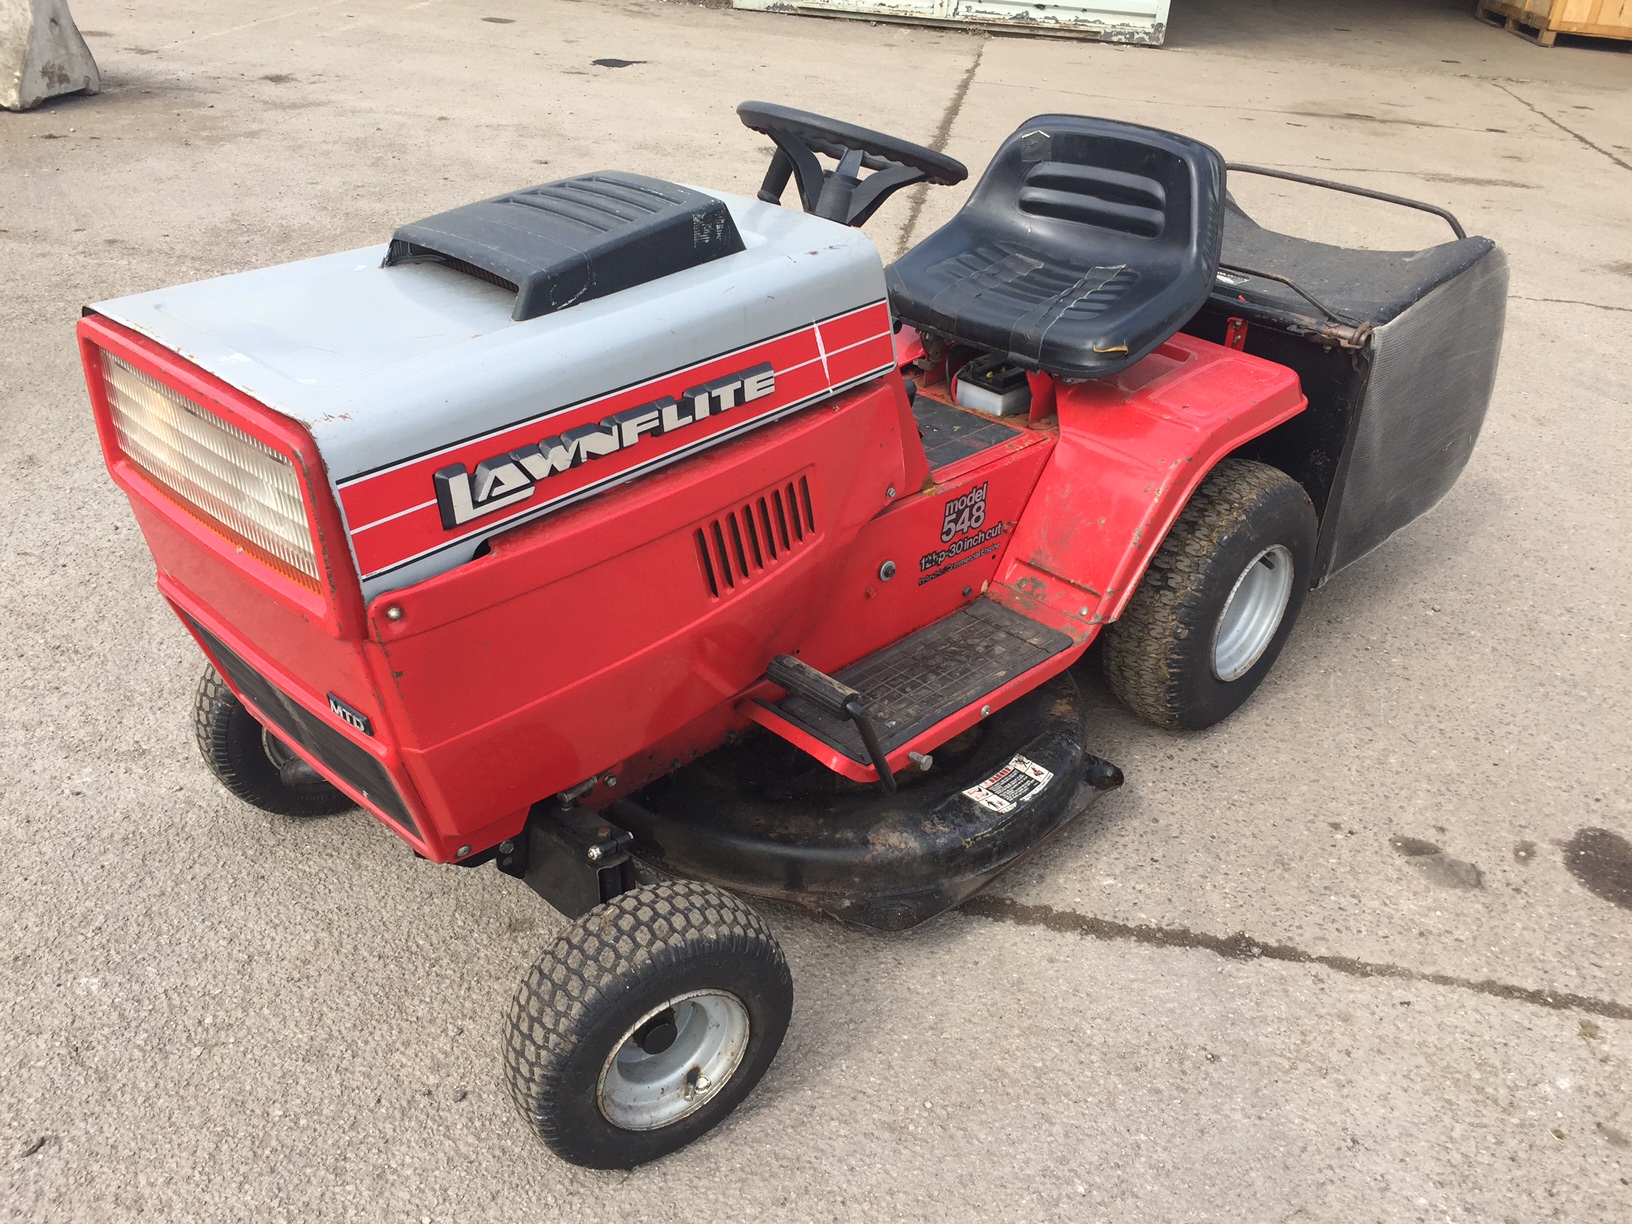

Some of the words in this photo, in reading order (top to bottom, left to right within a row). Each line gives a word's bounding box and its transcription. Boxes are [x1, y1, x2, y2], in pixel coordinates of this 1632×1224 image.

[435, 362, 776, 530] LAWNFLITE
[945, 481, 988, 516] model
[941, 500, 986, 543] 548
[963, 531, 985, 551] inch
[985, 521, 1003, 541] cut
[980, 542, 1001, 557] Engine
[329, 698, 366, 732] MTD
